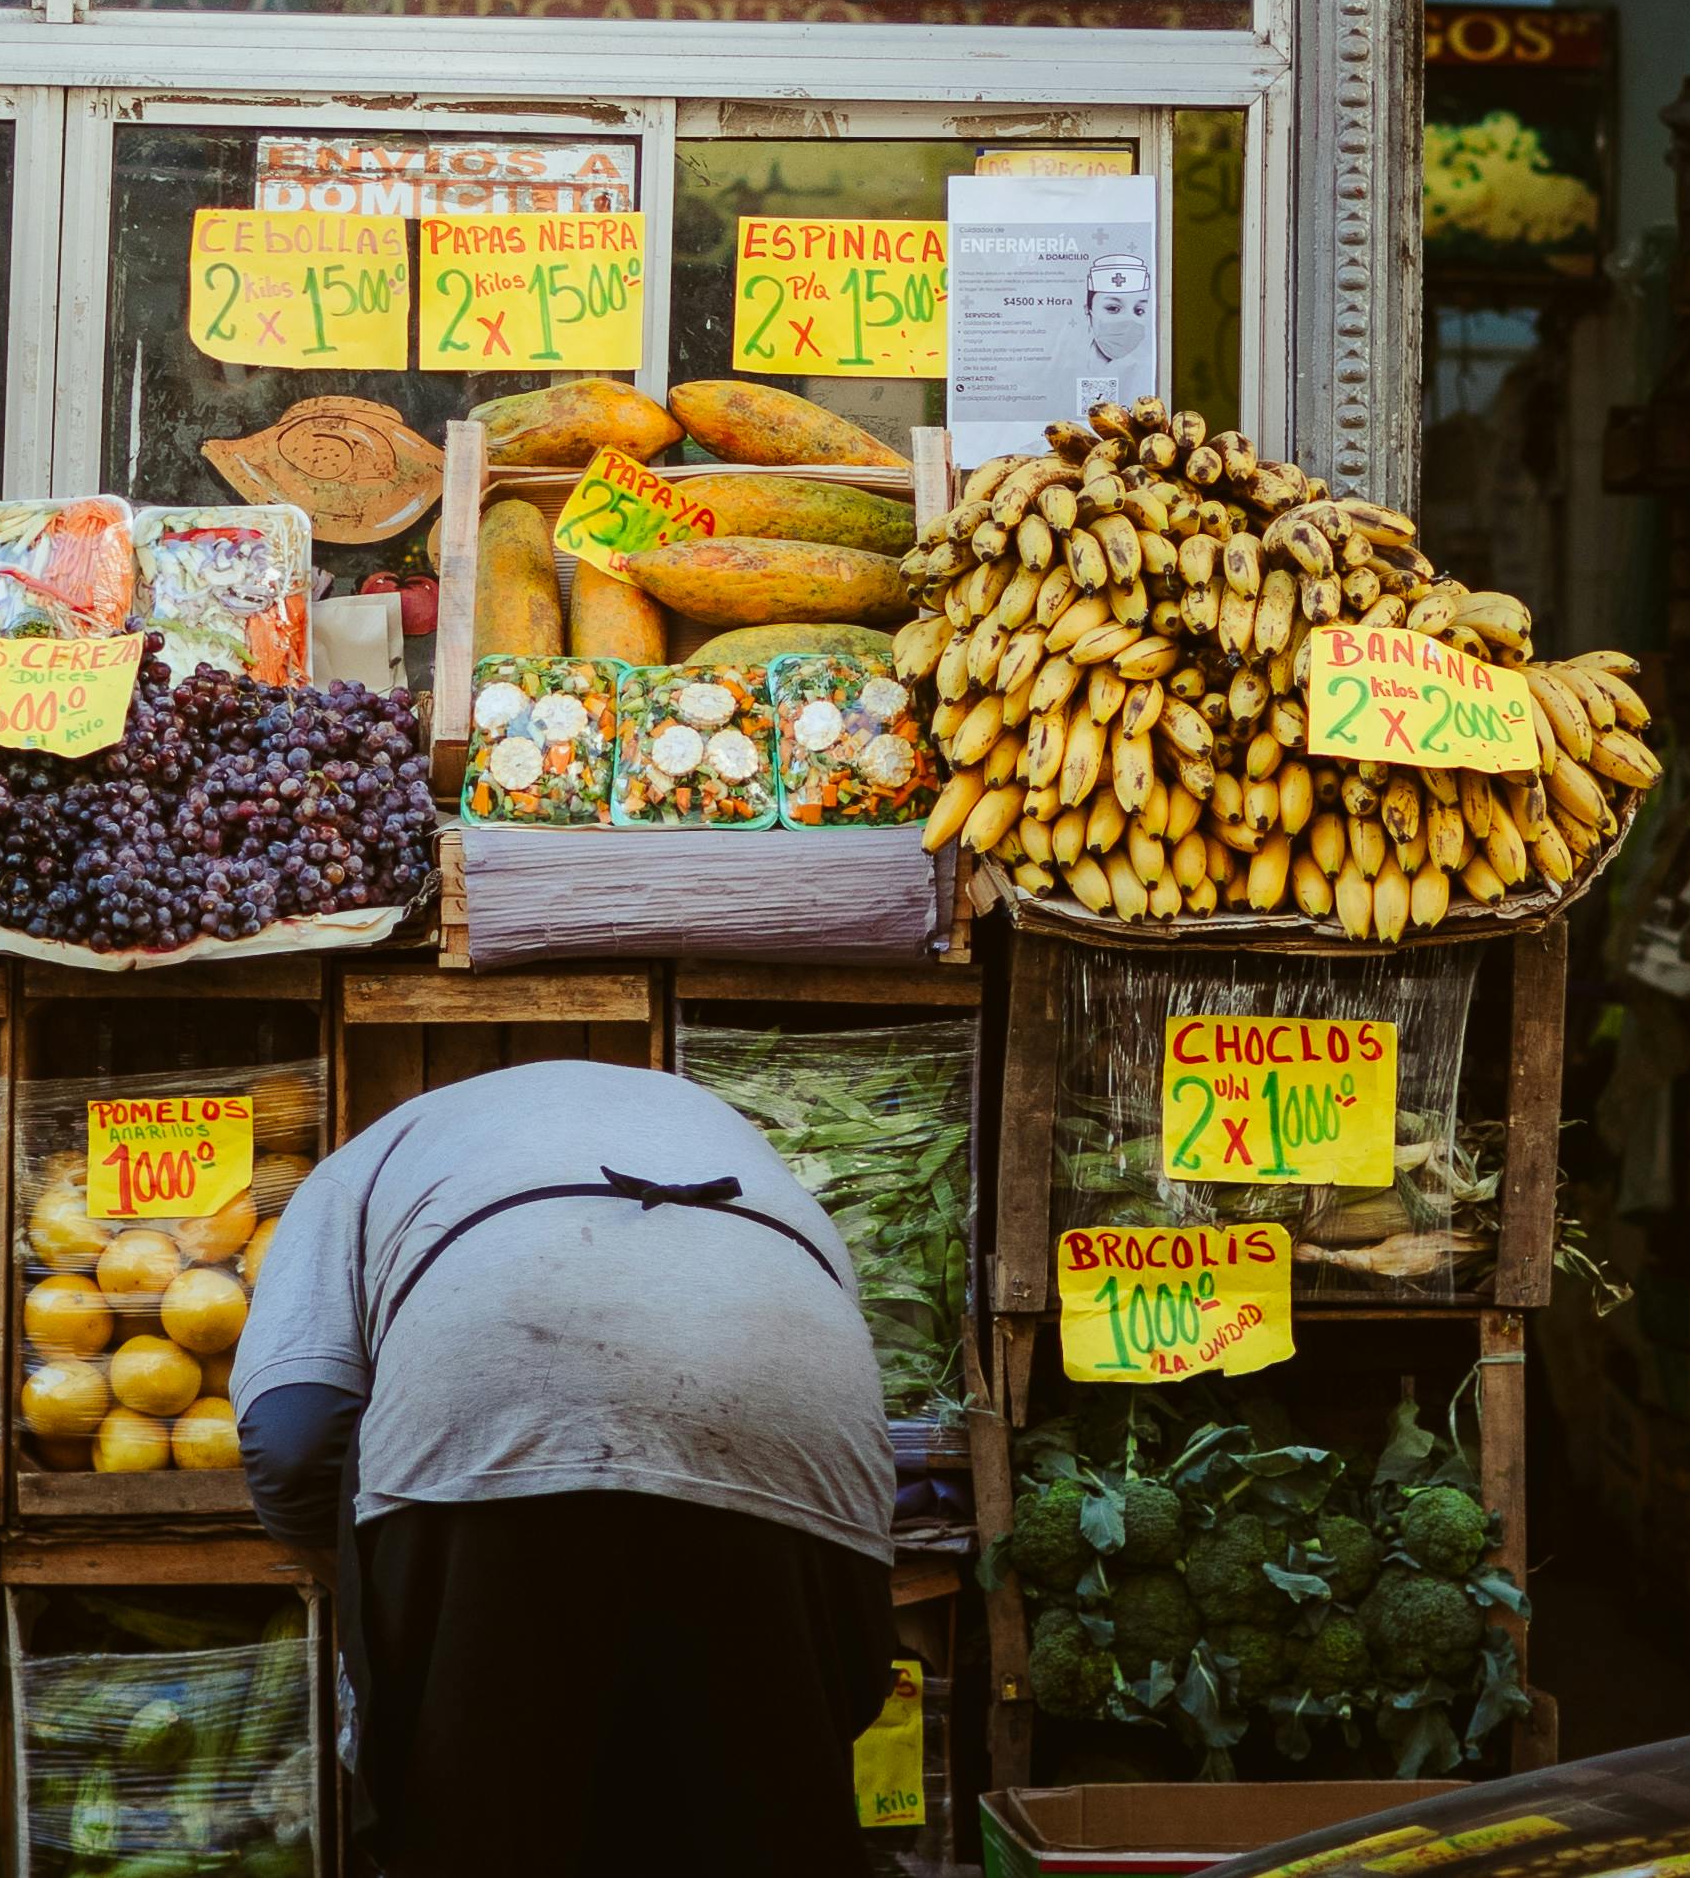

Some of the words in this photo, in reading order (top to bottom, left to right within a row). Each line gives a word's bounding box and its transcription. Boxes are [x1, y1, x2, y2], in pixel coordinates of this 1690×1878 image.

[267, 146, 549, 176] ENVIOS
[576, 152, 622, 178] A
[422, 218, 526, 255] PAPAS
[960, 233, 1080, 254] ENFERMERÍA
[1046, 253, 1090, 262] DOMICILIO
[203, 261, 242, 341] 2
[436, 268, 473, 352] 2
[474, 271, 526, 297] kilos
[742, 274, 785, 359] 2
[1003, 297, 1035, 307] $4500
[1046, 297, 1073, 307] Hora
[603, 451, 716, 538] PAPAYA
[20, 638, 141, 671] CEREZA
[1320, 628, 1494, 693] BANANA
[1325, 675, 1370, 745] 2
[1172, 1021, 1384, 1066] CHOCLOS
[89, 1100, 250, 1129] POMELOS
[1171, 1075, 1216, 1171] 2
[1064, 1229, 1277, 1271] BROCOLIS
